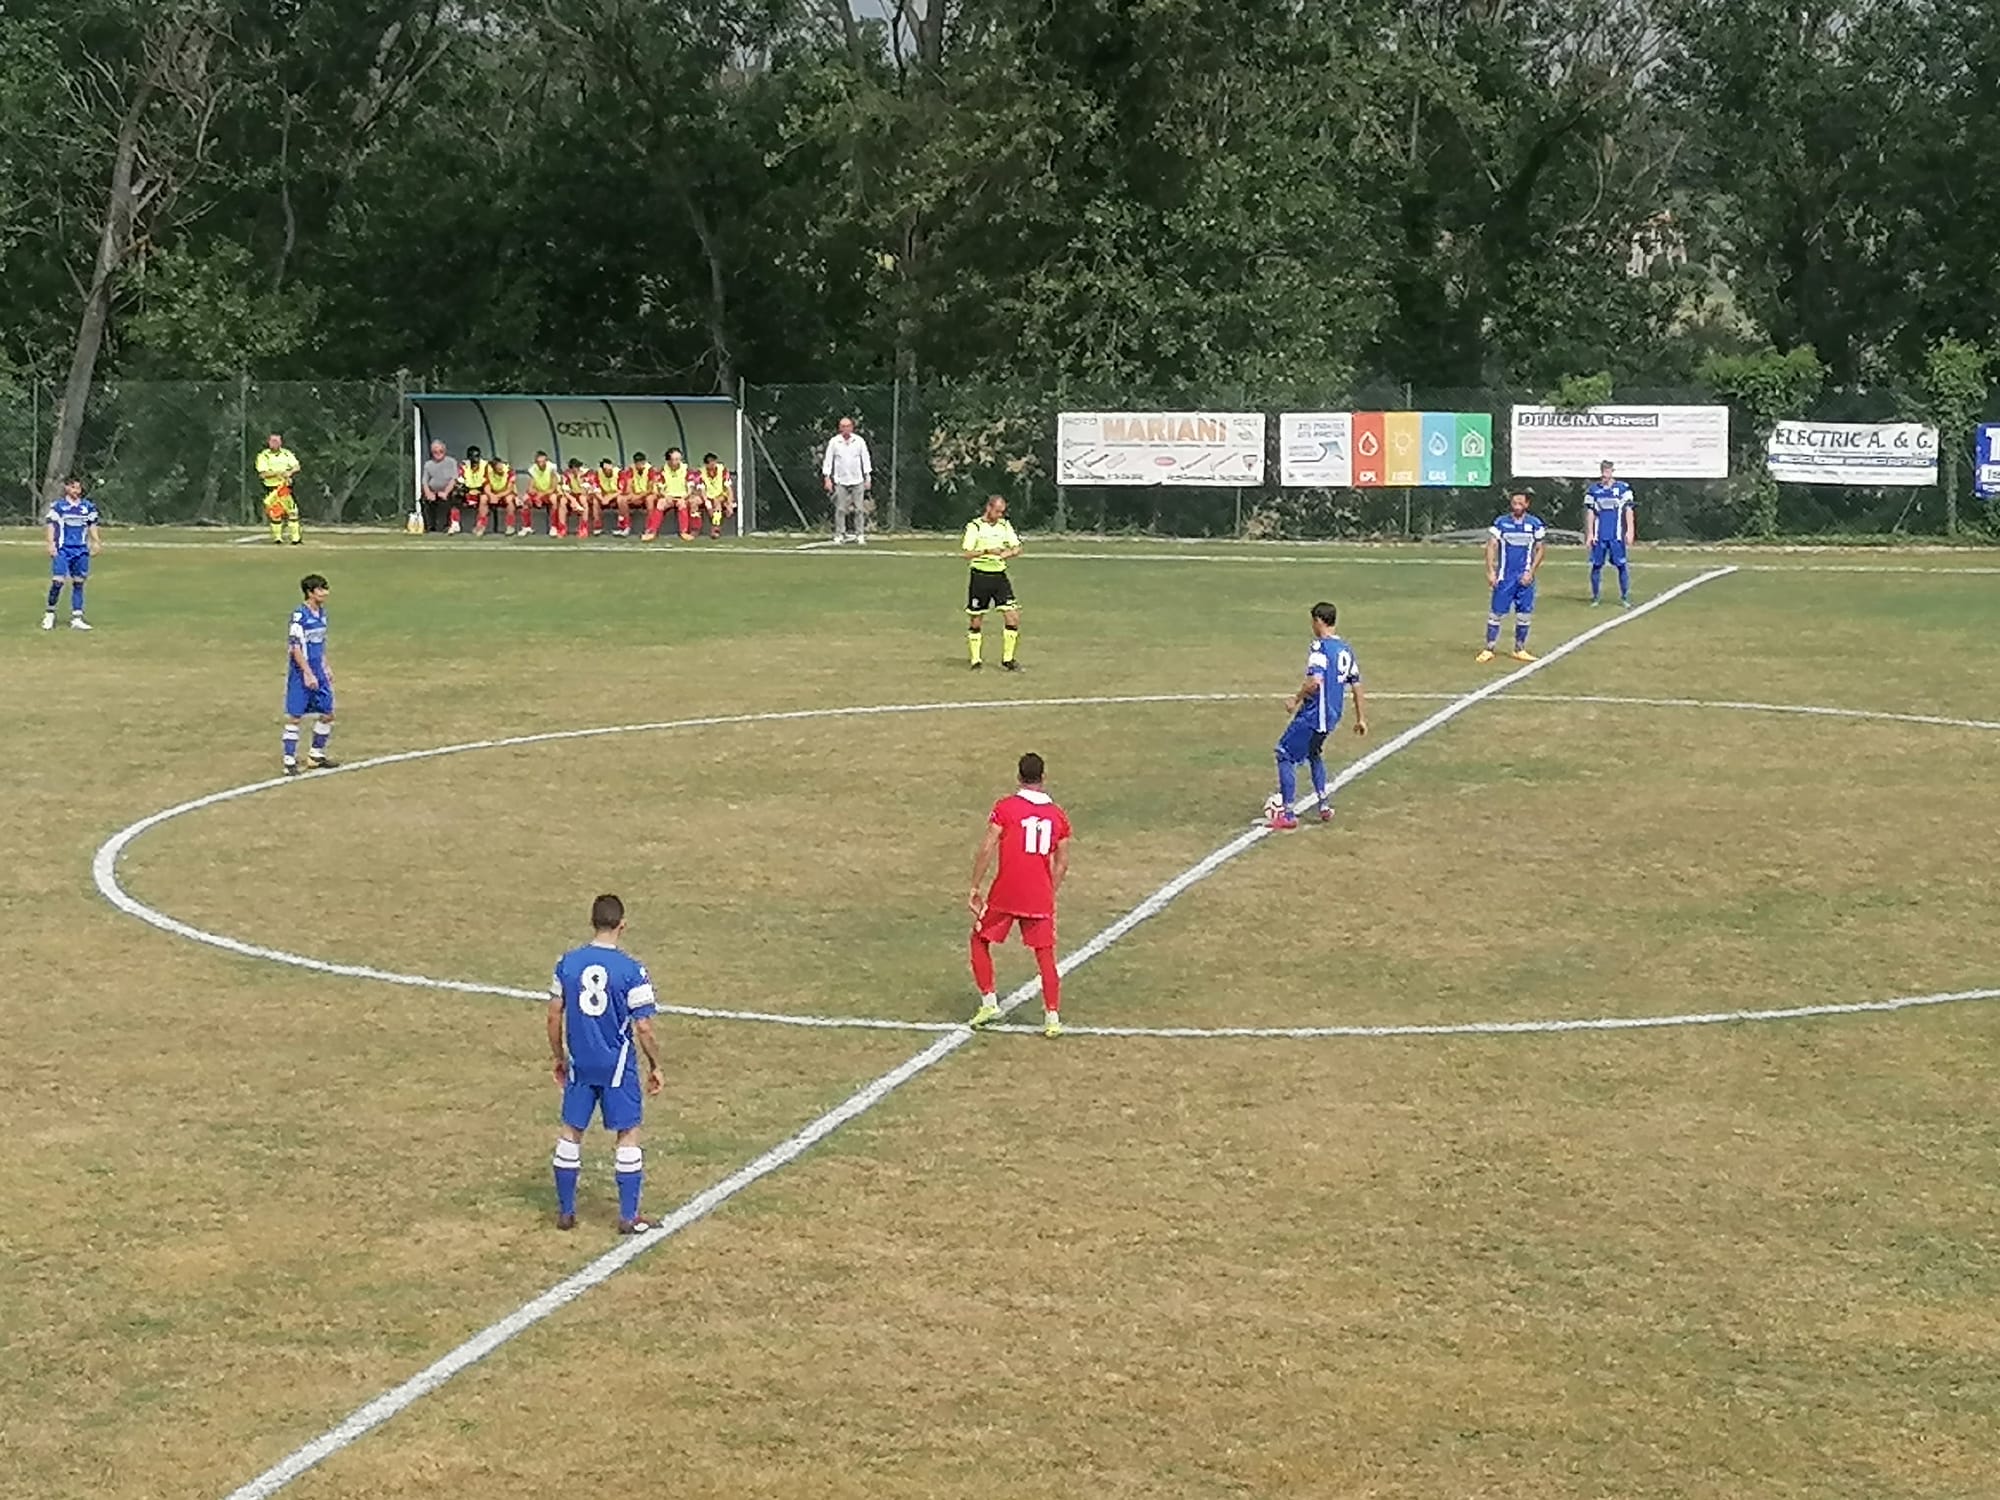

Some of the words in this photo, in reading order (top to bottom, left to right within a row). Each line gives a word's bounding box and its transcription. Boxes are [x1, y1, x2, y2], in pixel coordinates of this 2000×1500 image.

[1103, 417, 1228, 442] MARIANI
[1775, 428, 1862, 447] ELECTRIC
[1893, 431, 1909, 448] &
[1337, 649, 1352, 683] 9
[1020, 815, 1052, 855] 11
[579, 964, 608, 1016] 8
